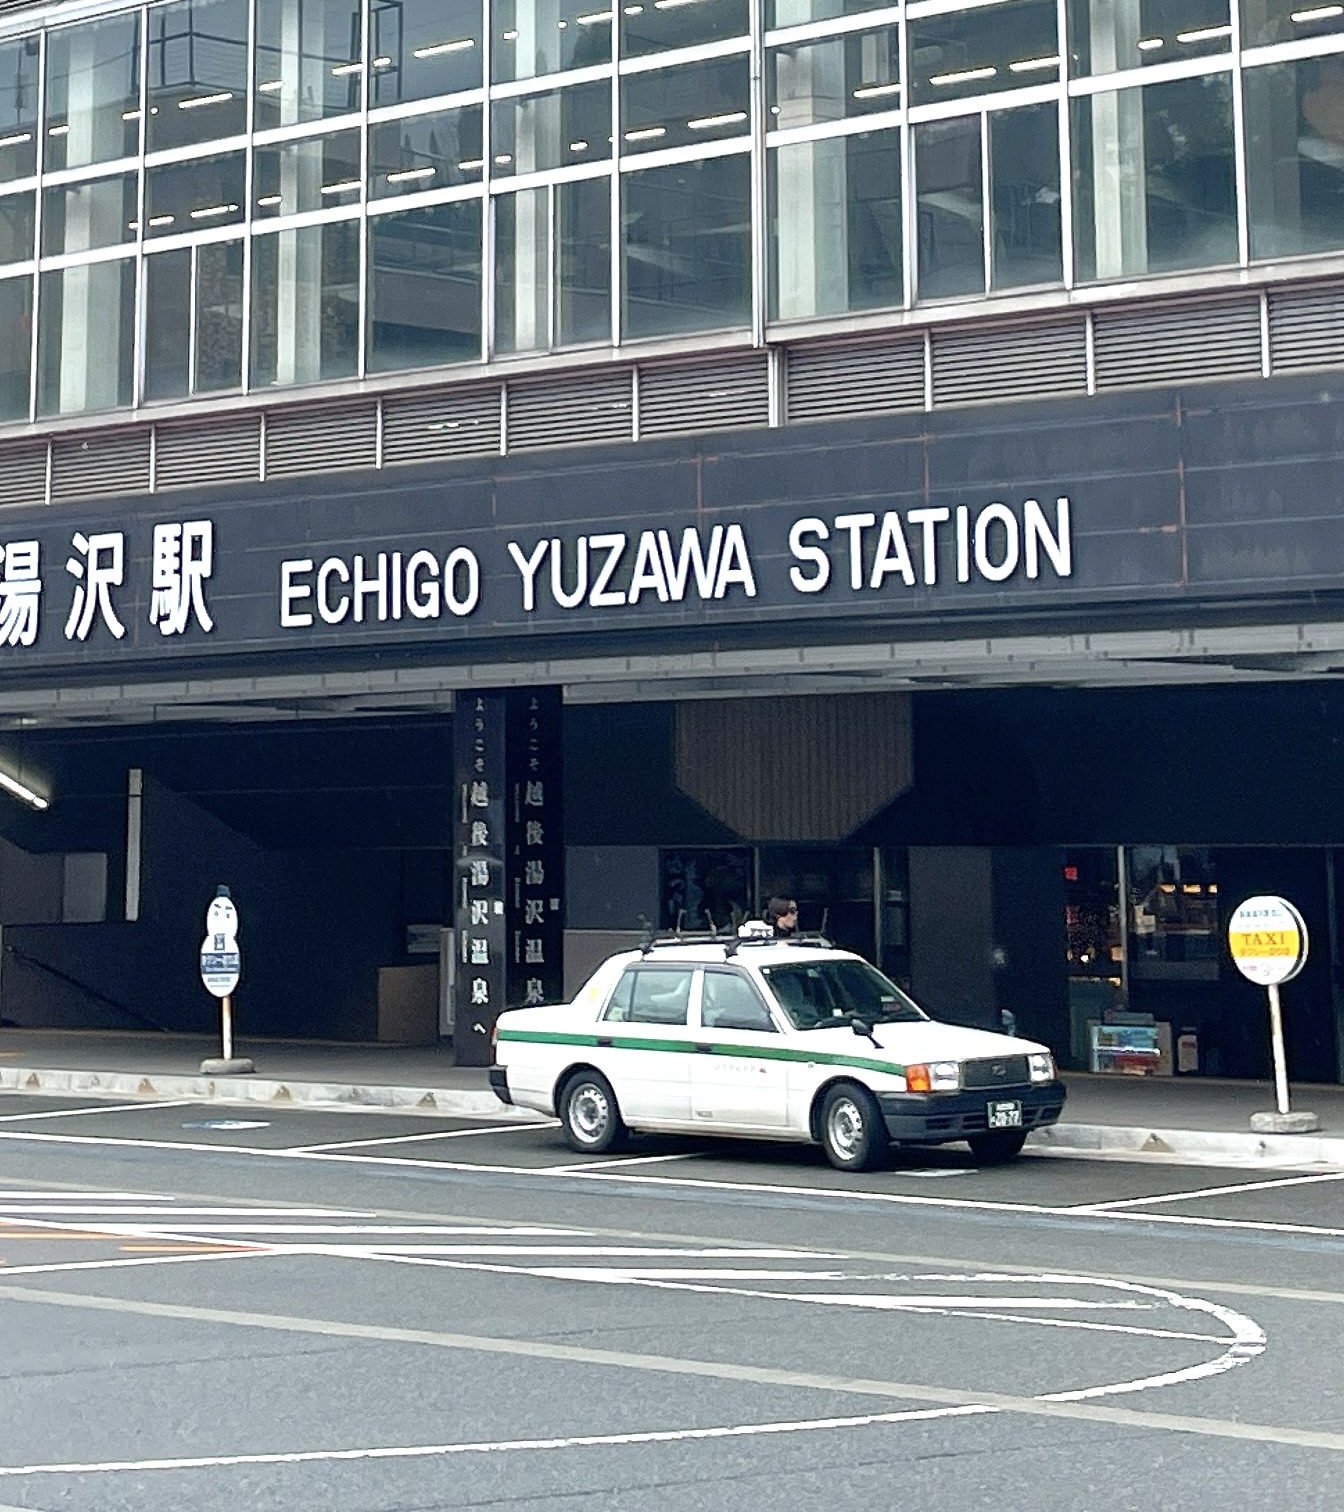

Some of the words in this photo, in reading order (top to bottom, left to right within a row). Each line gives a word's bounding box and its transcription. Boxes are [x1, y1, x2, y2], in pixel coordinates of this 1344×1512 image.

[279, 547, 479, 627] ECHIGO
[508, 523, 756, 610] YUZAWA
[789, 497, 1072, 592] STATION
[1242, 932, 1286, 946] TAXI
